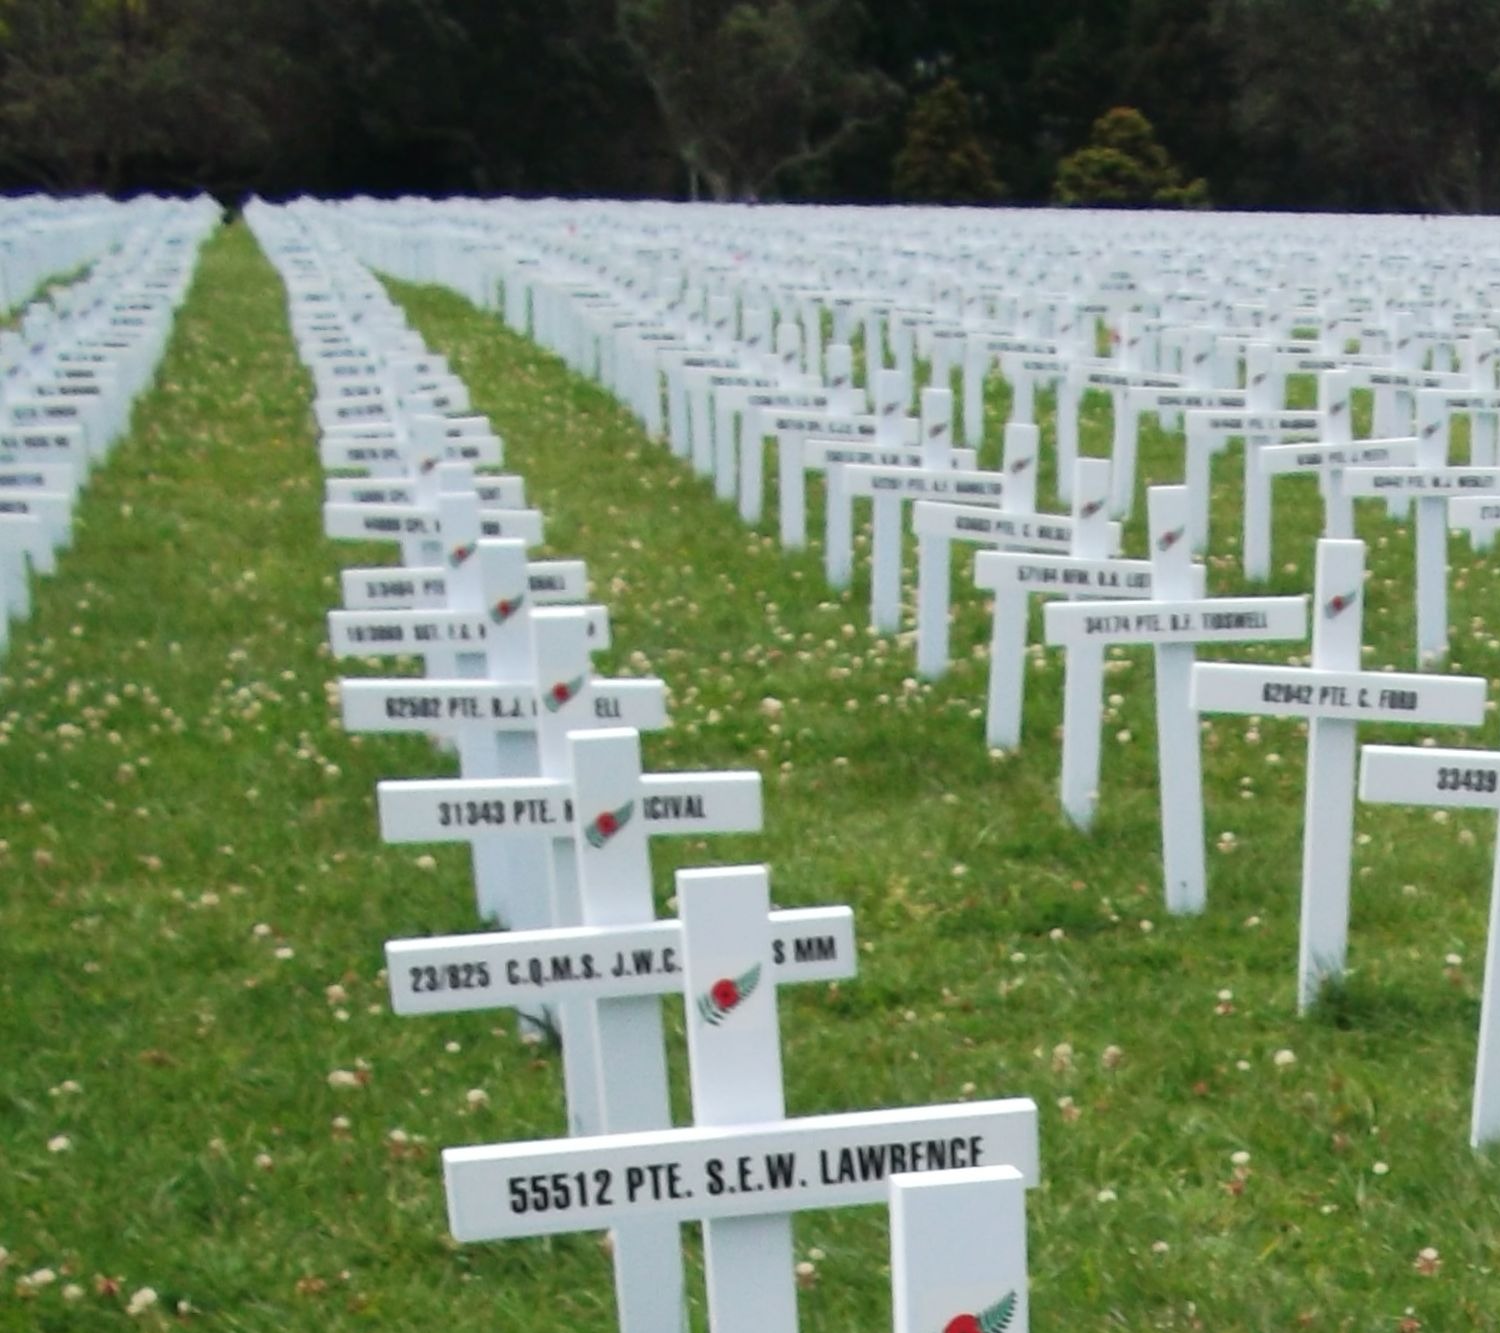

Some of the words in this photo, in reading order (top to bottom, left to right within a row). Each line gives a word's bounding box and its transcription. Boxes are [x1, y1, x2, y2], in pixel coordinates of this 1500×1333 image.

[1136, 615, 1162, 632] PTE.
[448, 697, 482, 718] PTE.
[1319, 686, 1348, 707] PTE.
[1358, 688, 1370, 708] C.
[439, 800, 505, 826] 31343
[513, 800, 555, 823] PTE.
[410, 962, 490, 993] 23/825
[506, 954, 601, 986] C.Q.M.S.
[612, 948, 681, 977] J.W.C.
[794, 936, 836, 962] MM
[509, 1169, 612, 1214] 55512
[626, 1163, 692, 1202] PTE.
[706, 1153, 806, 1195] S.E.W.
[820, 1136, 982, 1185] LAWRENCE
